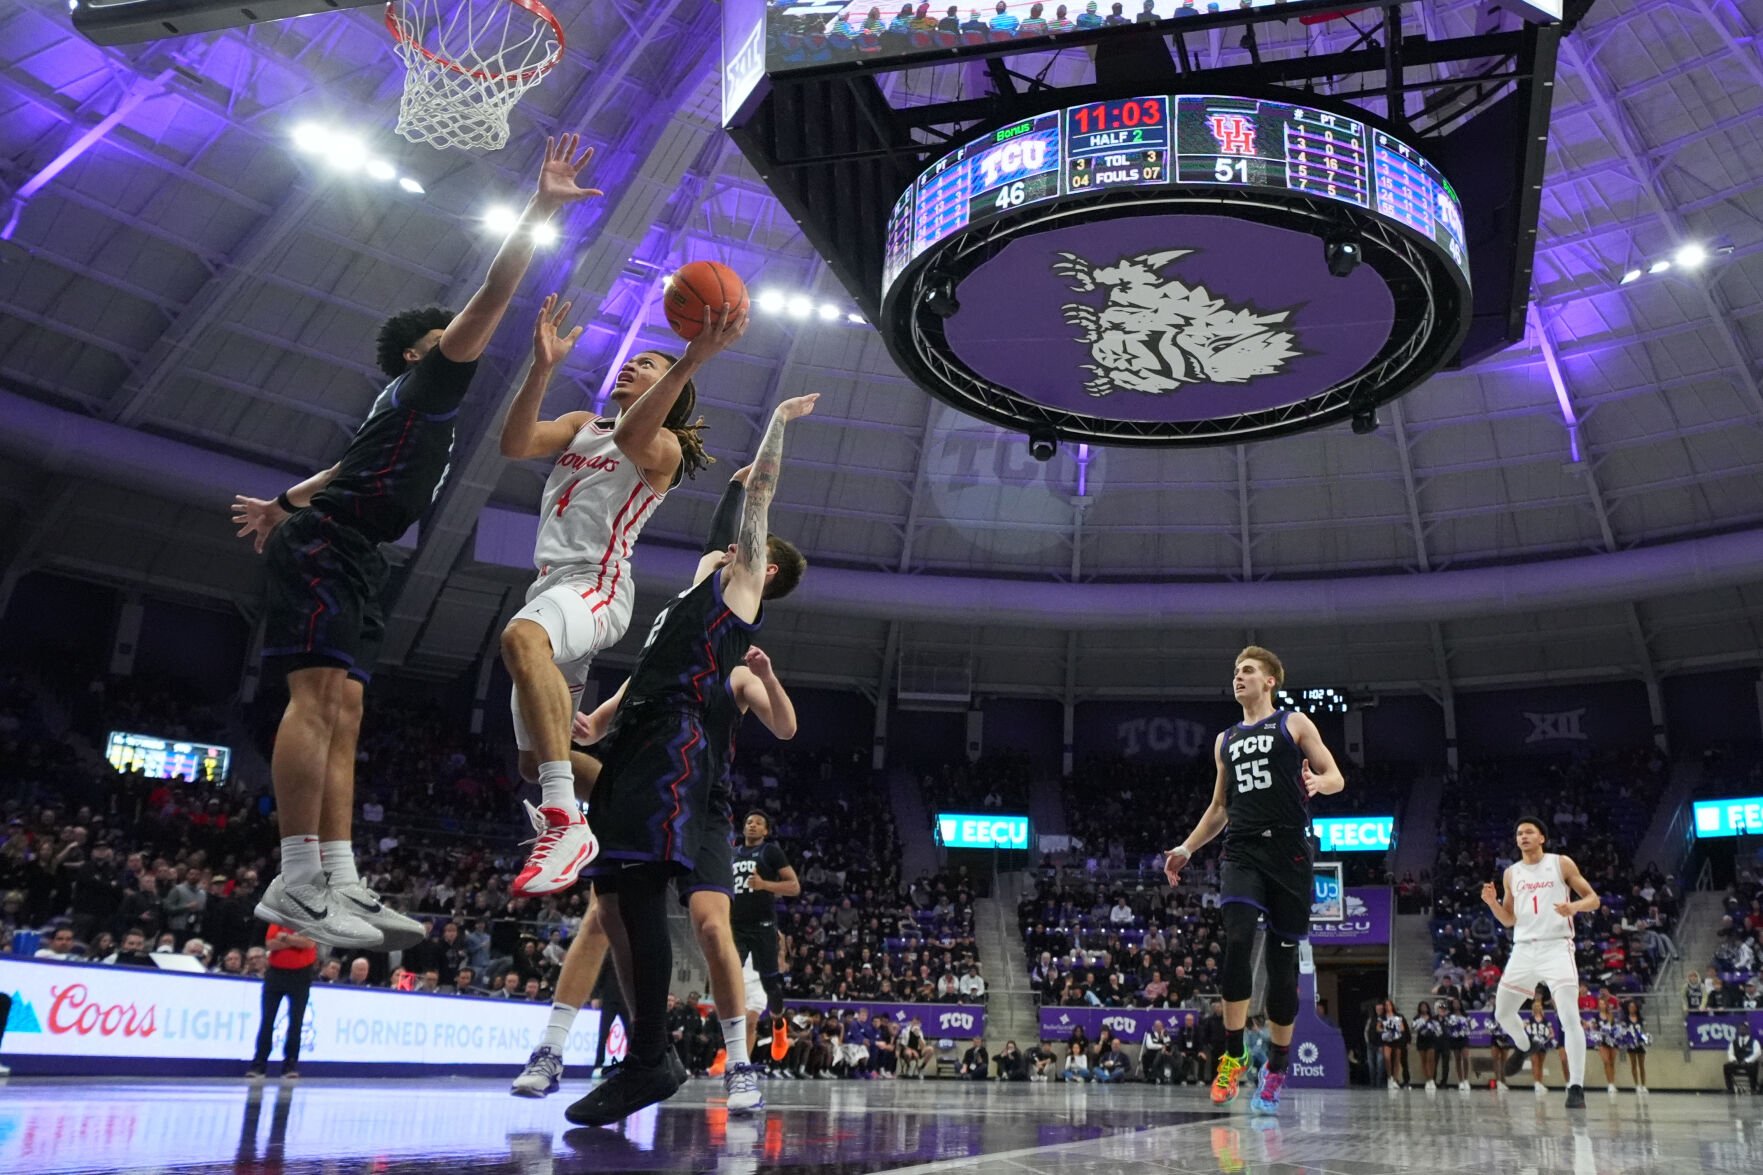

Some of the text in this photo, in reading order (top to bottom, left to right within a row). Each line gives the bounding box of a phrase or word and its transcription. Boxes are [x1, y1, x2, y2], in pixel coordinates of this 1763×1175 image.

[1075, 100, 1160, 132] 11:03
[1320, 114, 1336, 126] PT
[996, 123, 1030, 142] Bonus
[1090, 130, 1143, 146] HALF 2
[1298, 124, 1304, 136] 1
[1325, 130, 1333, 140] 0
[1076, 150, 1156, 170] 3 TOL 3
[1298, 138, 1359, 163] 3 0 1
[981, 140, 1046, 186] TCU
[1214, 157, 1248, 182] 51
[1324, 157, 1338, 170] 16
[1354, 166, 1359, 177] 1
[1072, 166, 1160, 188] 04 FOULS 07
[1327, 170, 1335, 181] 7
[1354, 179, 1360, 190] 1
[1381, 176, 1392, 188] 15
[995, 181, 1024, 208] 46
[1355, 192, 1361, 204] 1
[1119, 717, 1205, 757] TCU
[1228, 734, 1274, 762] TCU
[1235, 758, 1272, 794] 55
[962, 820, 1026, 844] EECU
[1330, 823, 1393, 845] EECU
[732, 860, 756, 876] TCU
[1533, 896, 1538, 914] 1
[47, 984, 250, 1042] Coors LIGHT
[940, 1012, 974, 1030] TCU
[336, 1018, 426, 1046] HORNED
[433, 1024, 483, 1048] FROG
[1102, 1016, 1136, 1033] TCU
[1697, 1023, 1737, 1043] TCU
[1293, 1064, 1324, 1077] Frost
